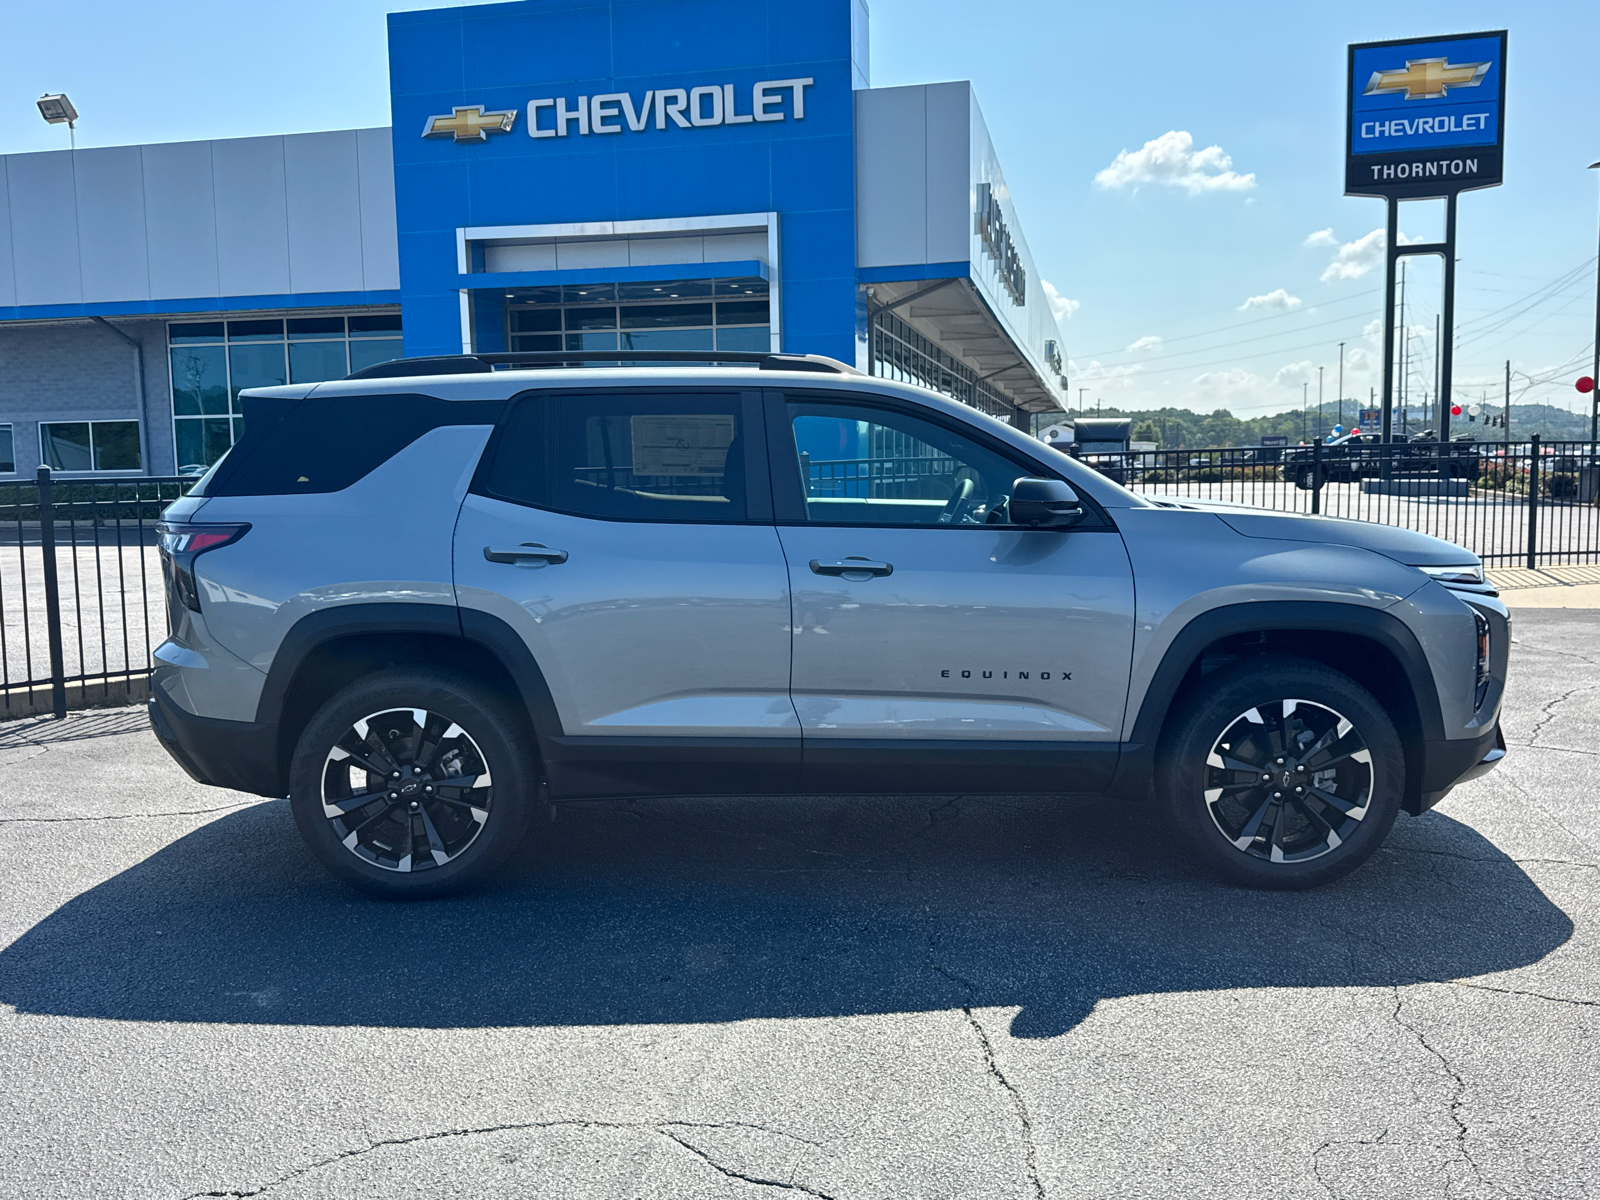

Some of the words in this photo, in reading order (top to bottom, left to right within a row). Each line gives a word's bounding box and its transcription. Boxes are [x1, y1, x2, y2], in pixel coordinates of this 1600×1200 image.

[527, 77, 813, 138] CHEVROLET
[1361, 113, 1490, 138] CHEVROLET
[1371, 158, 1478, 180] THORNTON
[940, 669, 1072, 681] EQUINOX
